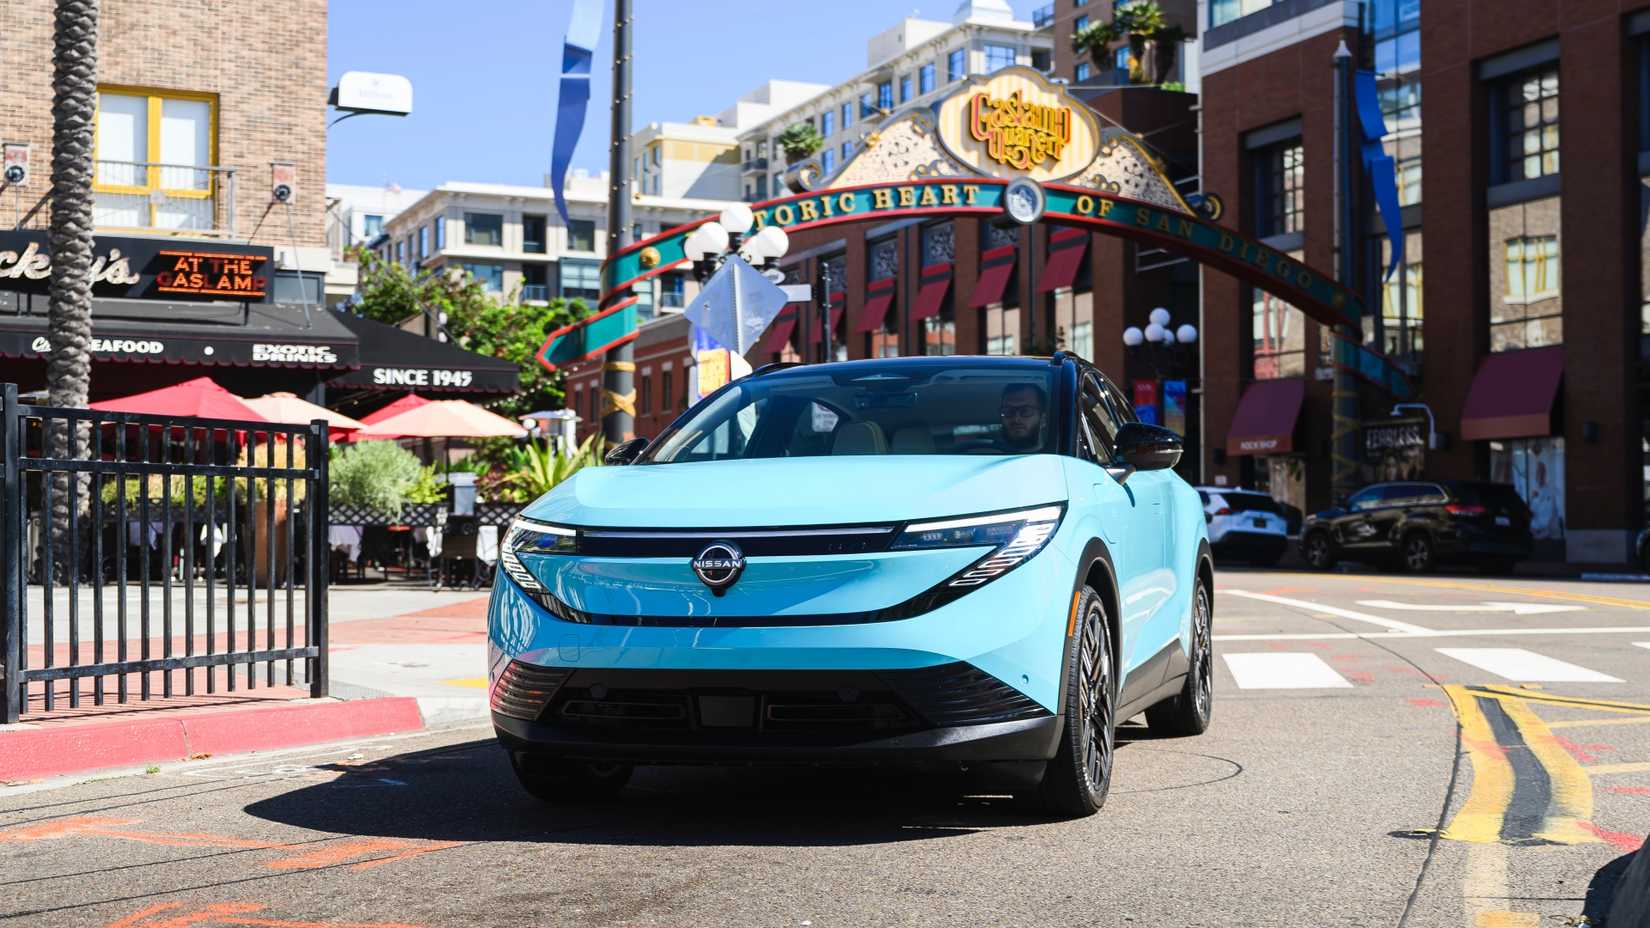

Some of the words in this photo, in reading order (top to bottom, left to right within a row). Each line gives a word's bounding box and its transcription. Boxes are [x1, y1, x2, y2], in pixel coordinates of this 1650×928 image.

[752, 192, 856, 232] TORIC
[873, 185, 980, 209] HEART
[1077, 195, 1115, 217] OF
[1136, 208, 1193, 239] SAN
[1220, 231, 1313, 289] DIEGO
[174, 256, 204, 272] AT
[207, 258, 253, 275] THE
[89, 339, 164, 353] EAFOOD
[252, 344, 331, 354] EXOTIC
[252, 353, 337, 363] DRINKS
[373, 368, 429, 386] SINCE
[432, 370, 473, 387] 1945
[693, 560, 741, 568] NISSAN
